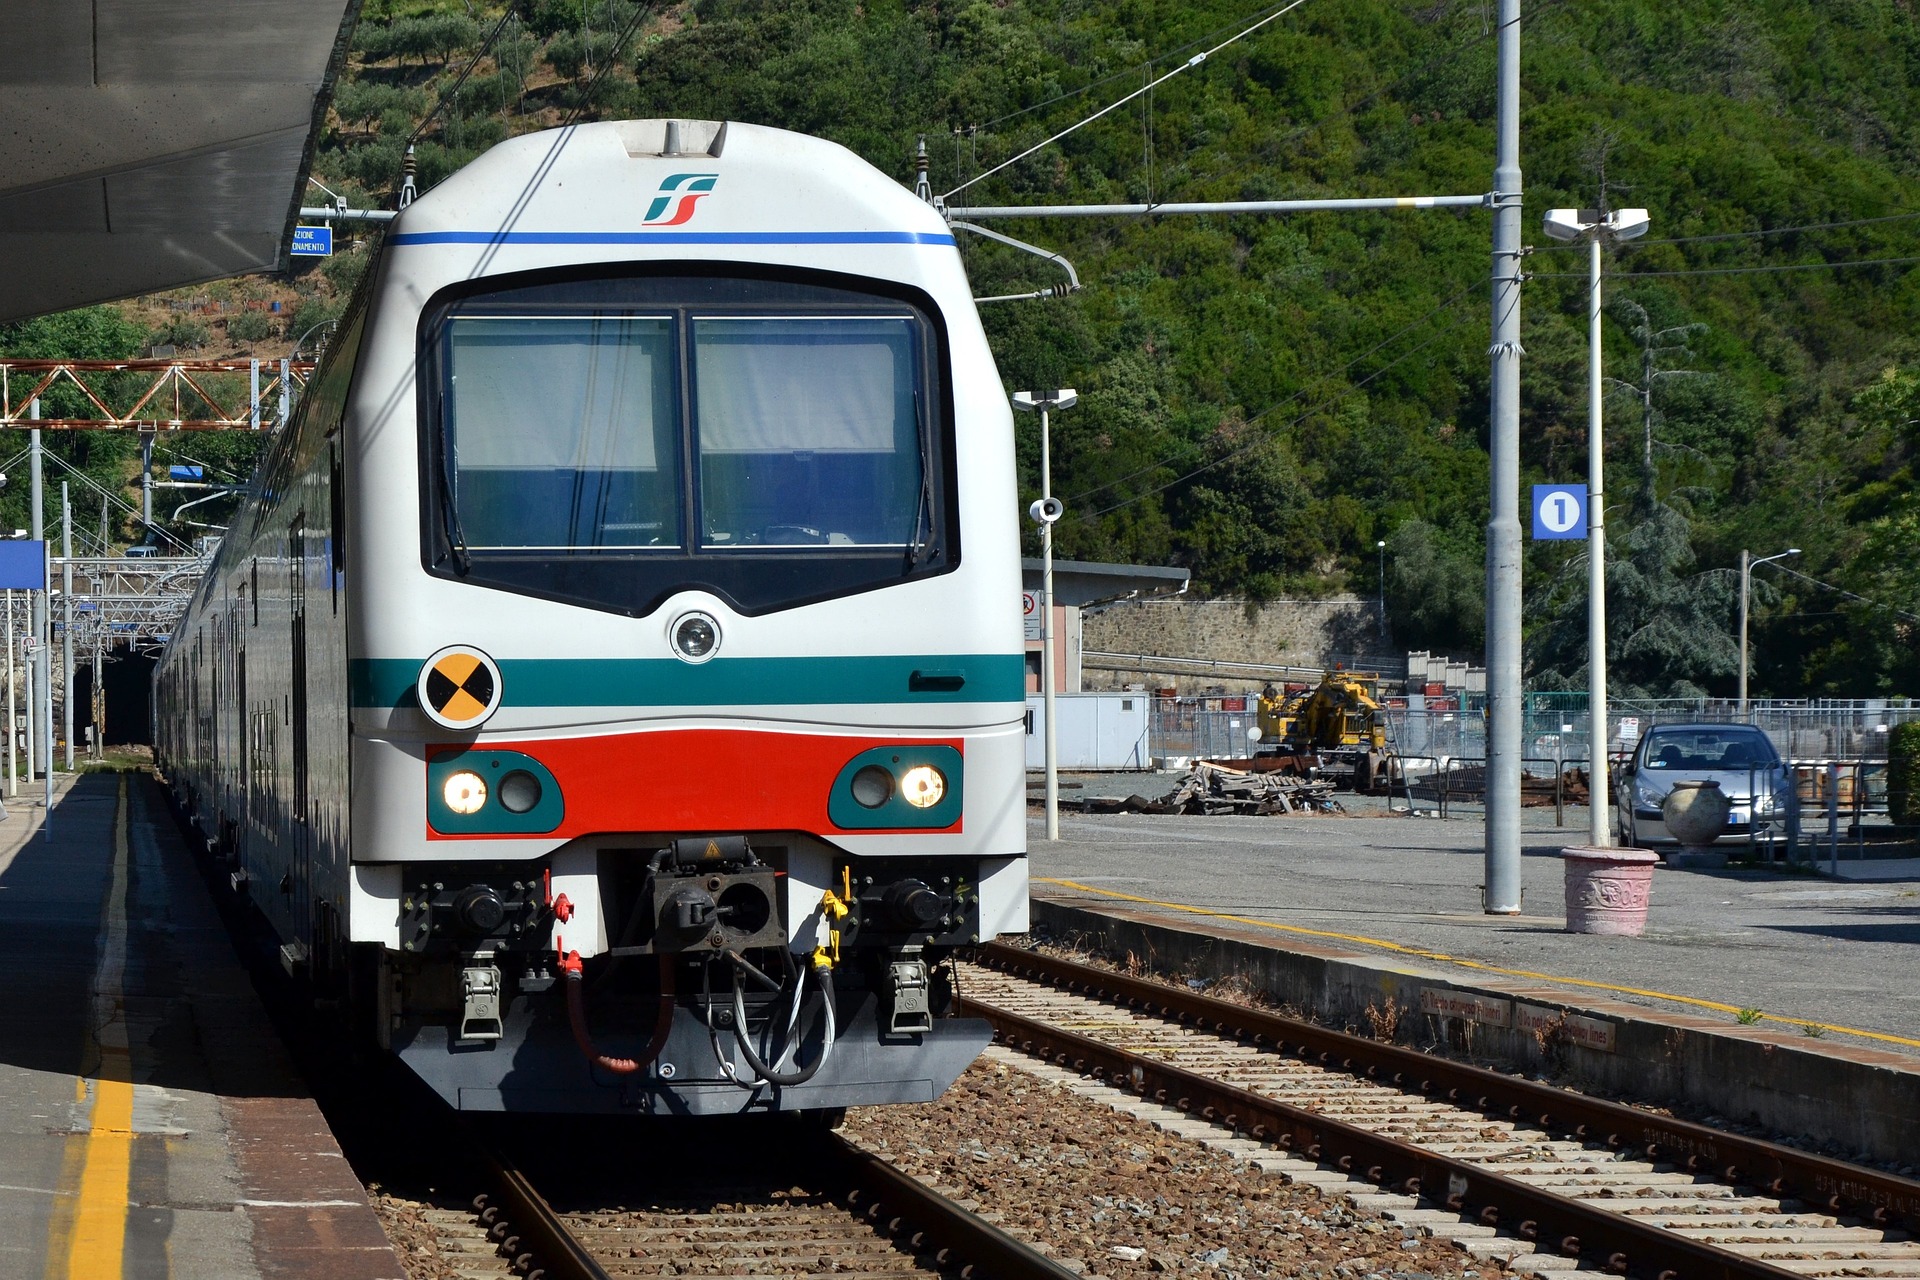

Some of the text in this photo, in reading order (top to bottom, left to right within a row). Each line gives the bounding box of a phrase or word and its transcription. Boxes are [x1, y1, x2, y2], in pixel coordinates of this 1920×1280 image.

[292, 242, 325, 251] ONAMENTO
[1554, 498, 1566, 525] 1
[1589, 1024, 1607, 1044] lines
